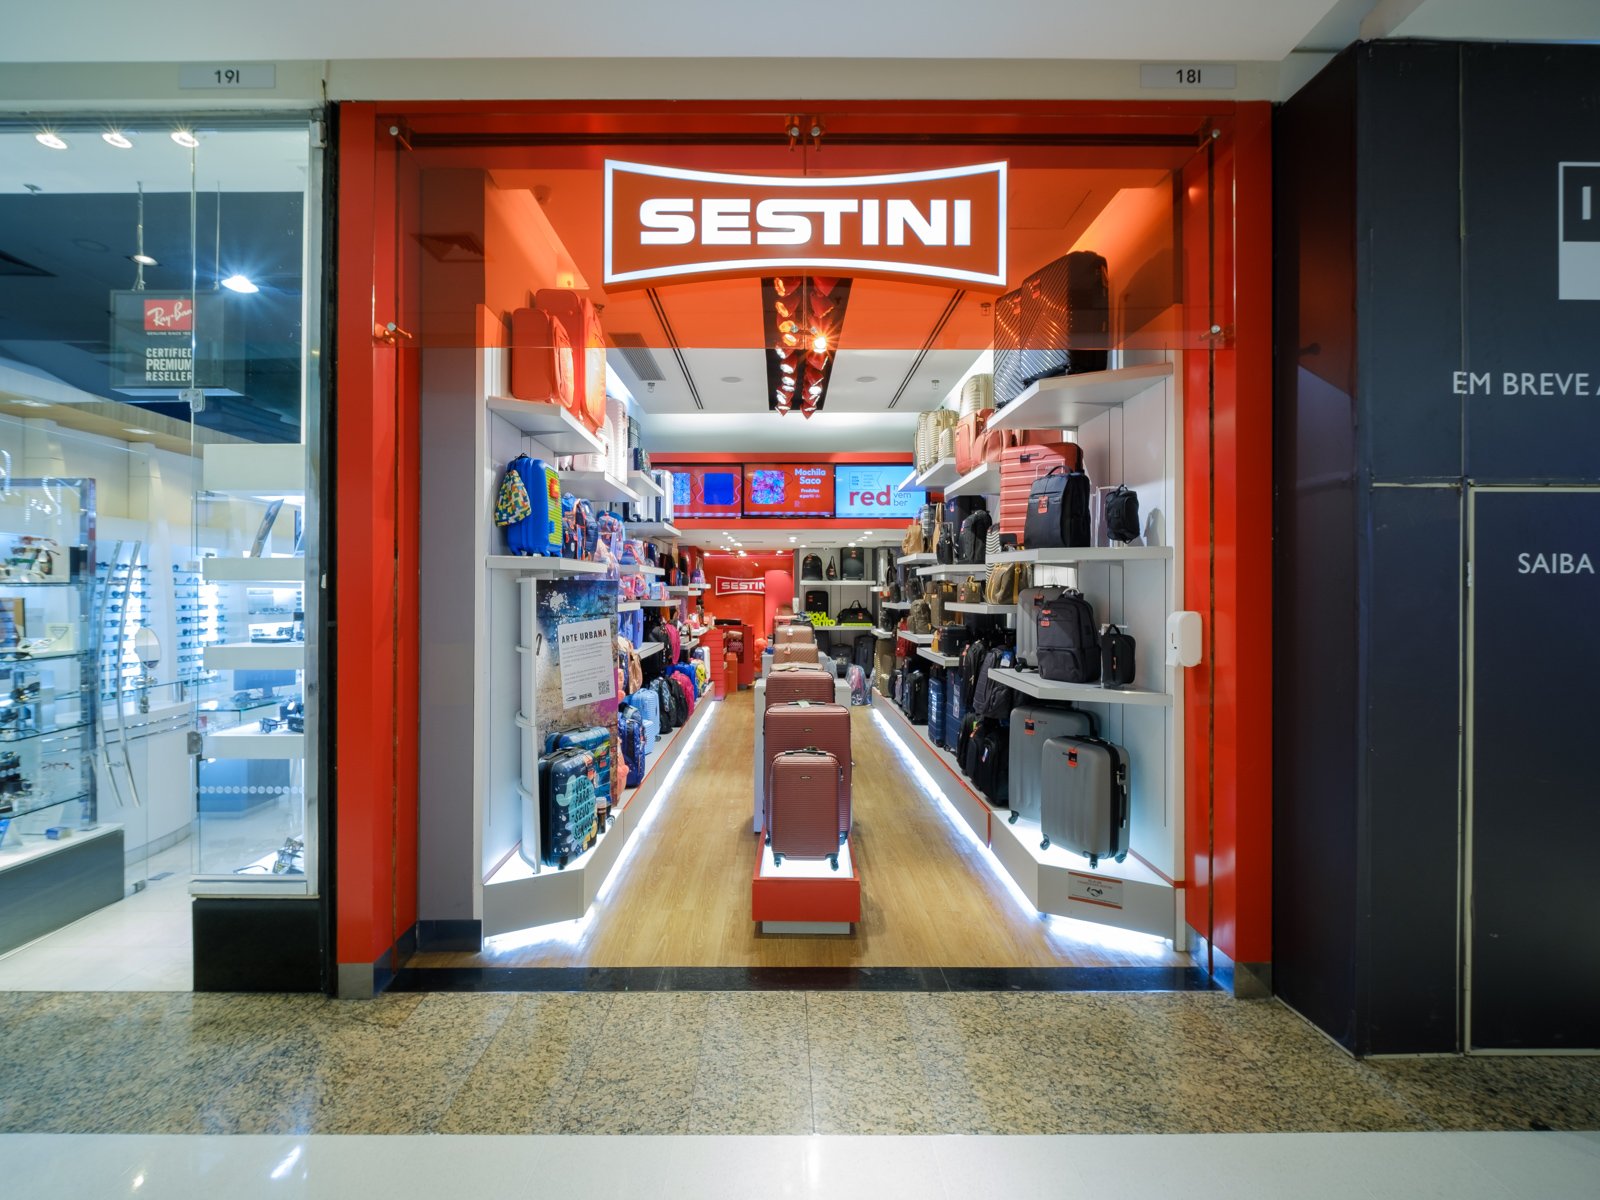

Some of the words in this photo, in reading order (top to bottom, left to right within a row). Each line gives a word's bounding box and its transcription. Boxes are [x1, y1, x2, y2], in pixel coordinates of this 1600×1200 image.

[639, 198, 971, 246] SESTINI
[147, 302, 193, 327] Ray-Ban
[145, 358, 192, 371] PREMIUM
[145, 371, 192, 381] RESELLER
[1453, 371, 1491, 395] EM
[1503, 372, 1590, 396] BREVE
[794, 468, 826, 476] Mochila
[800, 476, 821, 485] Saco
[849, 485, 891, 506] red
[1518, 552, 1595, 574] SAIBA
[721, 581, 766, 590] SESTIN
[561, 633, 578, 644] ARTE
[580, 629, 607, 641] URBANA
